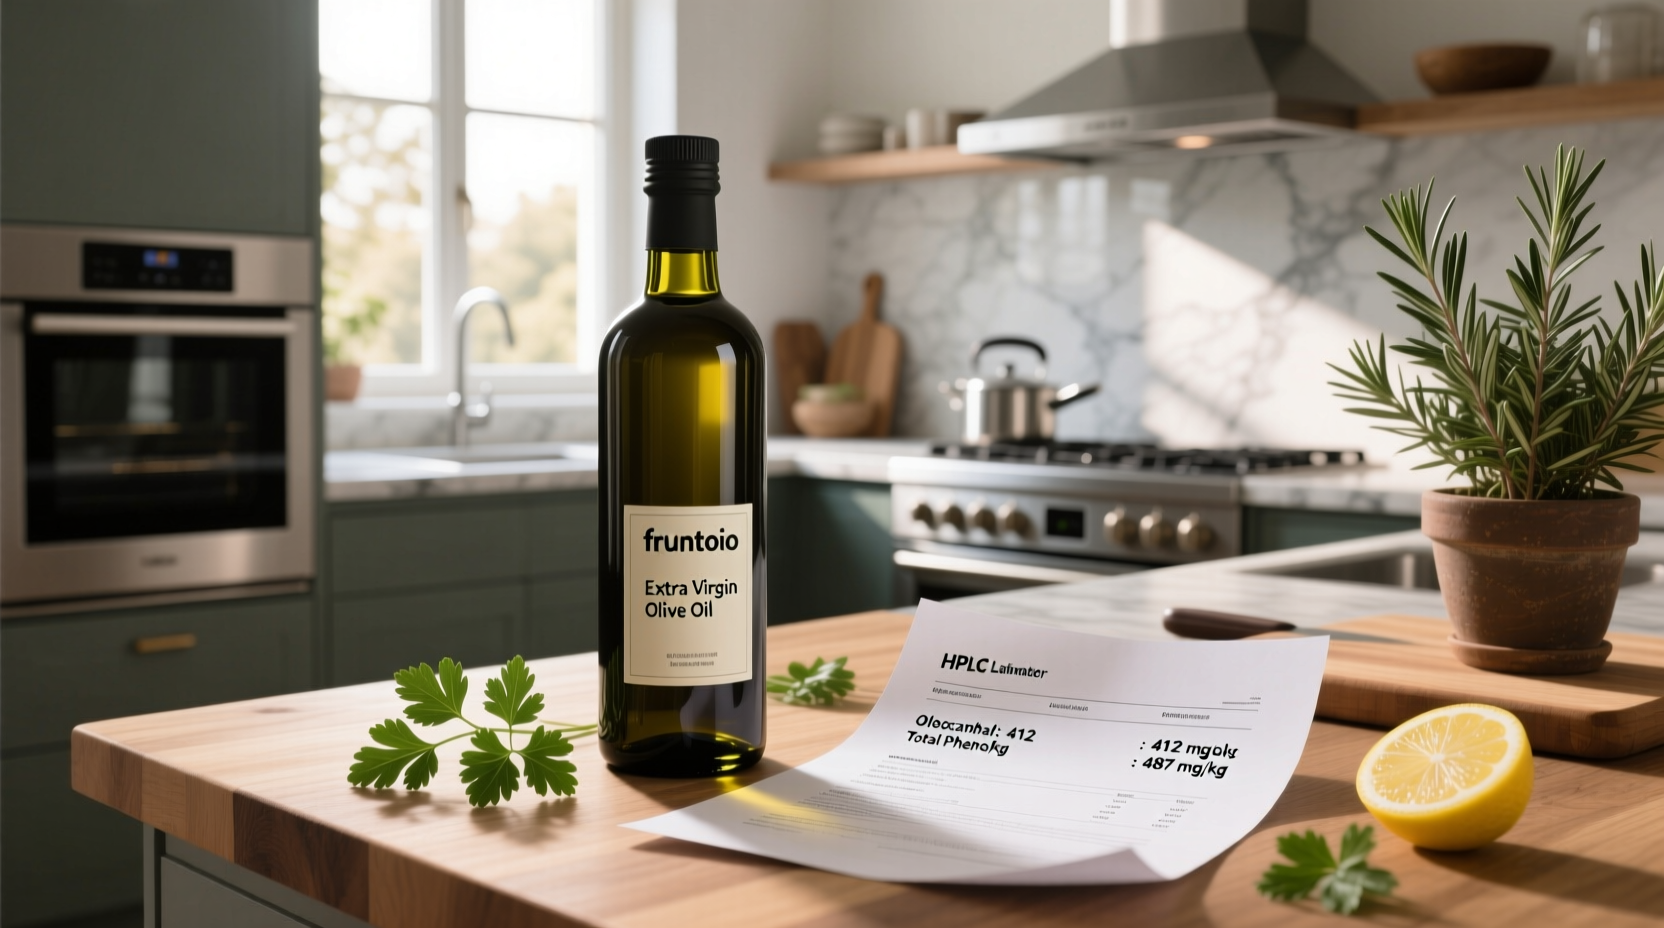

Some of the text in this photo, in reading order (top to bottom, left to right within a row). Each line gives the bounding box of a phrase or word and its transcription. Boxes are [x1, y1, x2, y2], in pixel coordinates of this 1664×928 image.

[643, 527, 739, 552] fruntoio
[645, 578, 738, 599] Extra Virgin
[645, 600, 713, 618] Olive Oil
[940, 652, 989, 673] HPLC
[907, 730, 942, 746] Total
[1006, 727, 1037, 742] 412
[1150, 738, 1183, 753] 412
[1142, 756, 1176, 771] 487
[1176, 761, 1229, 779] mg/kg
